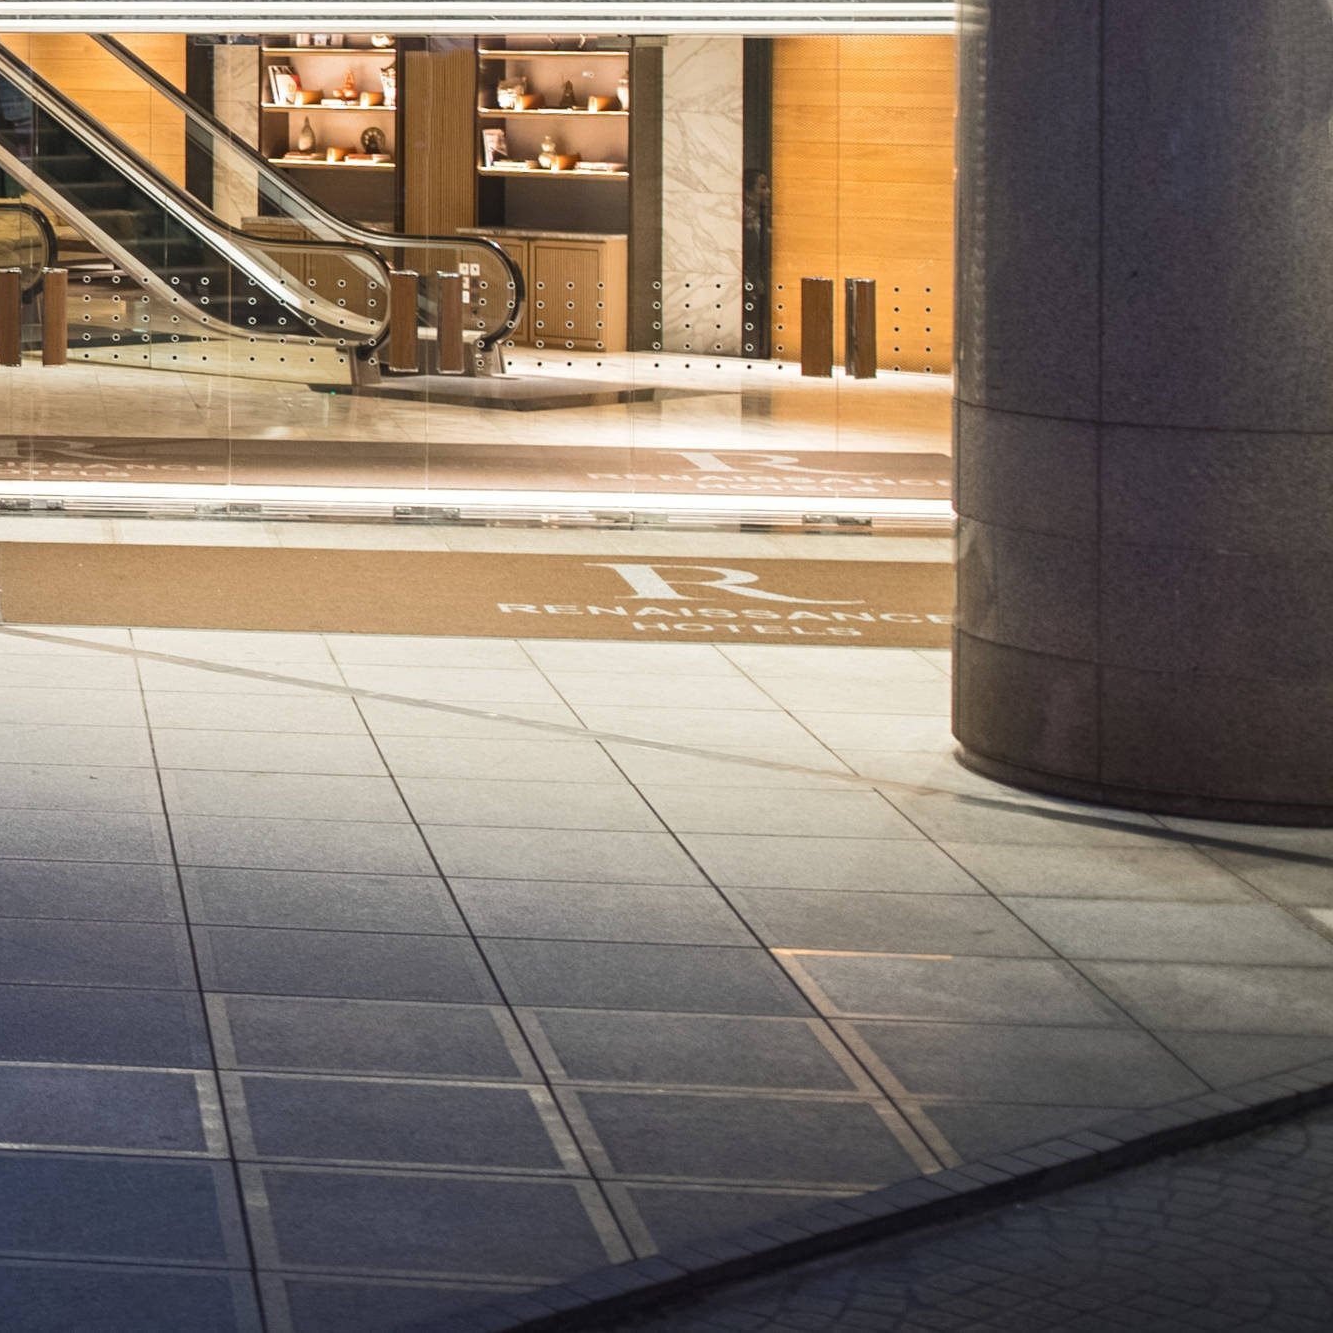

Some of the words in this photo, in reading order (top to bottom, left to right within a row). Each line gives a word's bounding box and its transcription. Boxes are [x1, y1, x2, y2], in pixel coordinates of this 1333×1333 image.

[696, 483, 879, 493] HOTELS
[582, 562, 866, 605] R
[496, 601, 953, 625] RENAISSANCE
[632, 621, 862, 637] HOTELS
